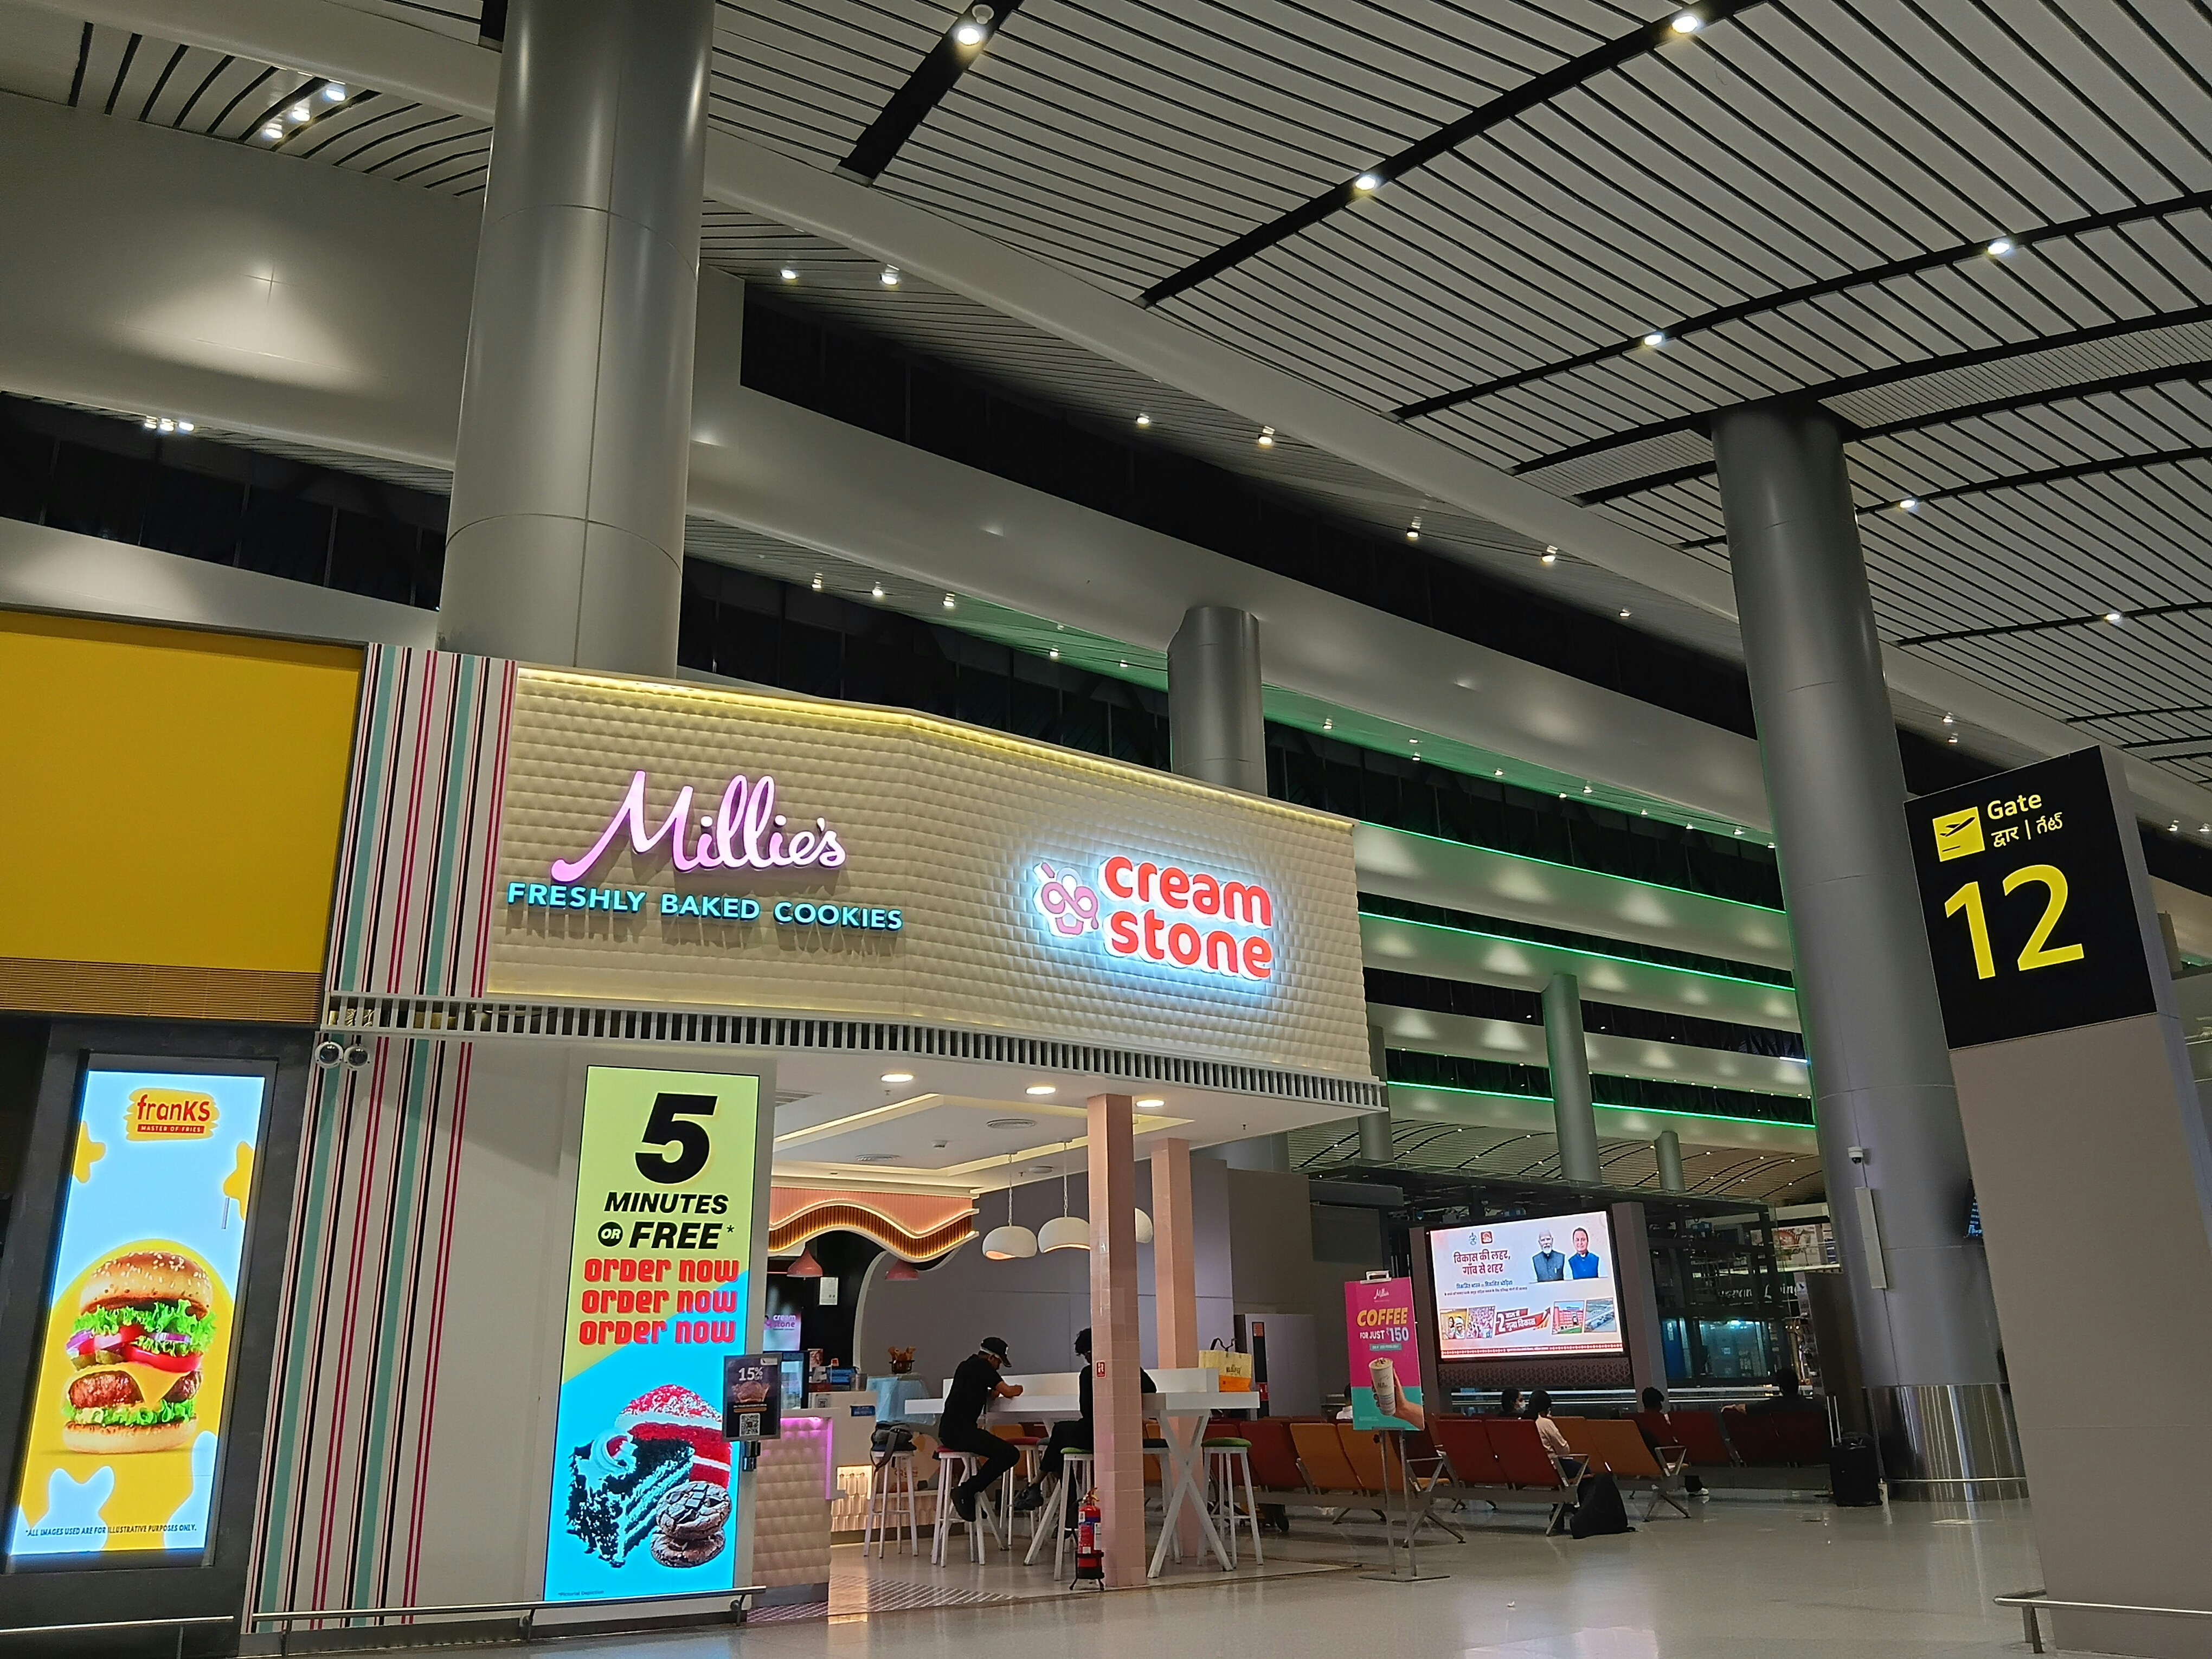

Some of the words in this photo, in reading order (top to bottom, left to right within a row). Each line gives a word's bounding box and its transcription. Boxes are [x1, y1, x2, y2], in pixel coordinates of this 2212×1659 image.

[1988, 795, 2042, 820] Gate
[551, 770, 846, 883] Millie's
[1991, 827, 2019, 847] द्वार
[2036, 812, 2062, 834] గేట్
[1105, 856, 1272, 927] cream
[507, 881, 646, 913] FRESHLY
[661, 894, 760, 921] BAKED
[774, 901, 903, 931] COOKIES
[1944, 864, 2084, 980] 12
[1110, 909, 1272, 978] stone
[635, 1093, 717, 1184] 5
[604, 1192, 729, 1214] MINUTES
[601, 1228, 620, 1240] OR
[1454, 1252, 1478, 1263] विकास
[1479, 1249, 1490, 1260] की
[1491, 1250, 1510, 1260] लहर,
[679, 1259, 739, 1283] now
[1478, 1263, 1486, 1274] से
[1488, 1264, 1503, 1273] शहर
[677, 1290, 737, 1314] now
[1357, 1307, 1408, 1327] COFFEE
[1497, 1313, 1506, 1332] 2
[675, 1321, 736, 1345] now
[1369, 1330, 1385, 1339] JUST
